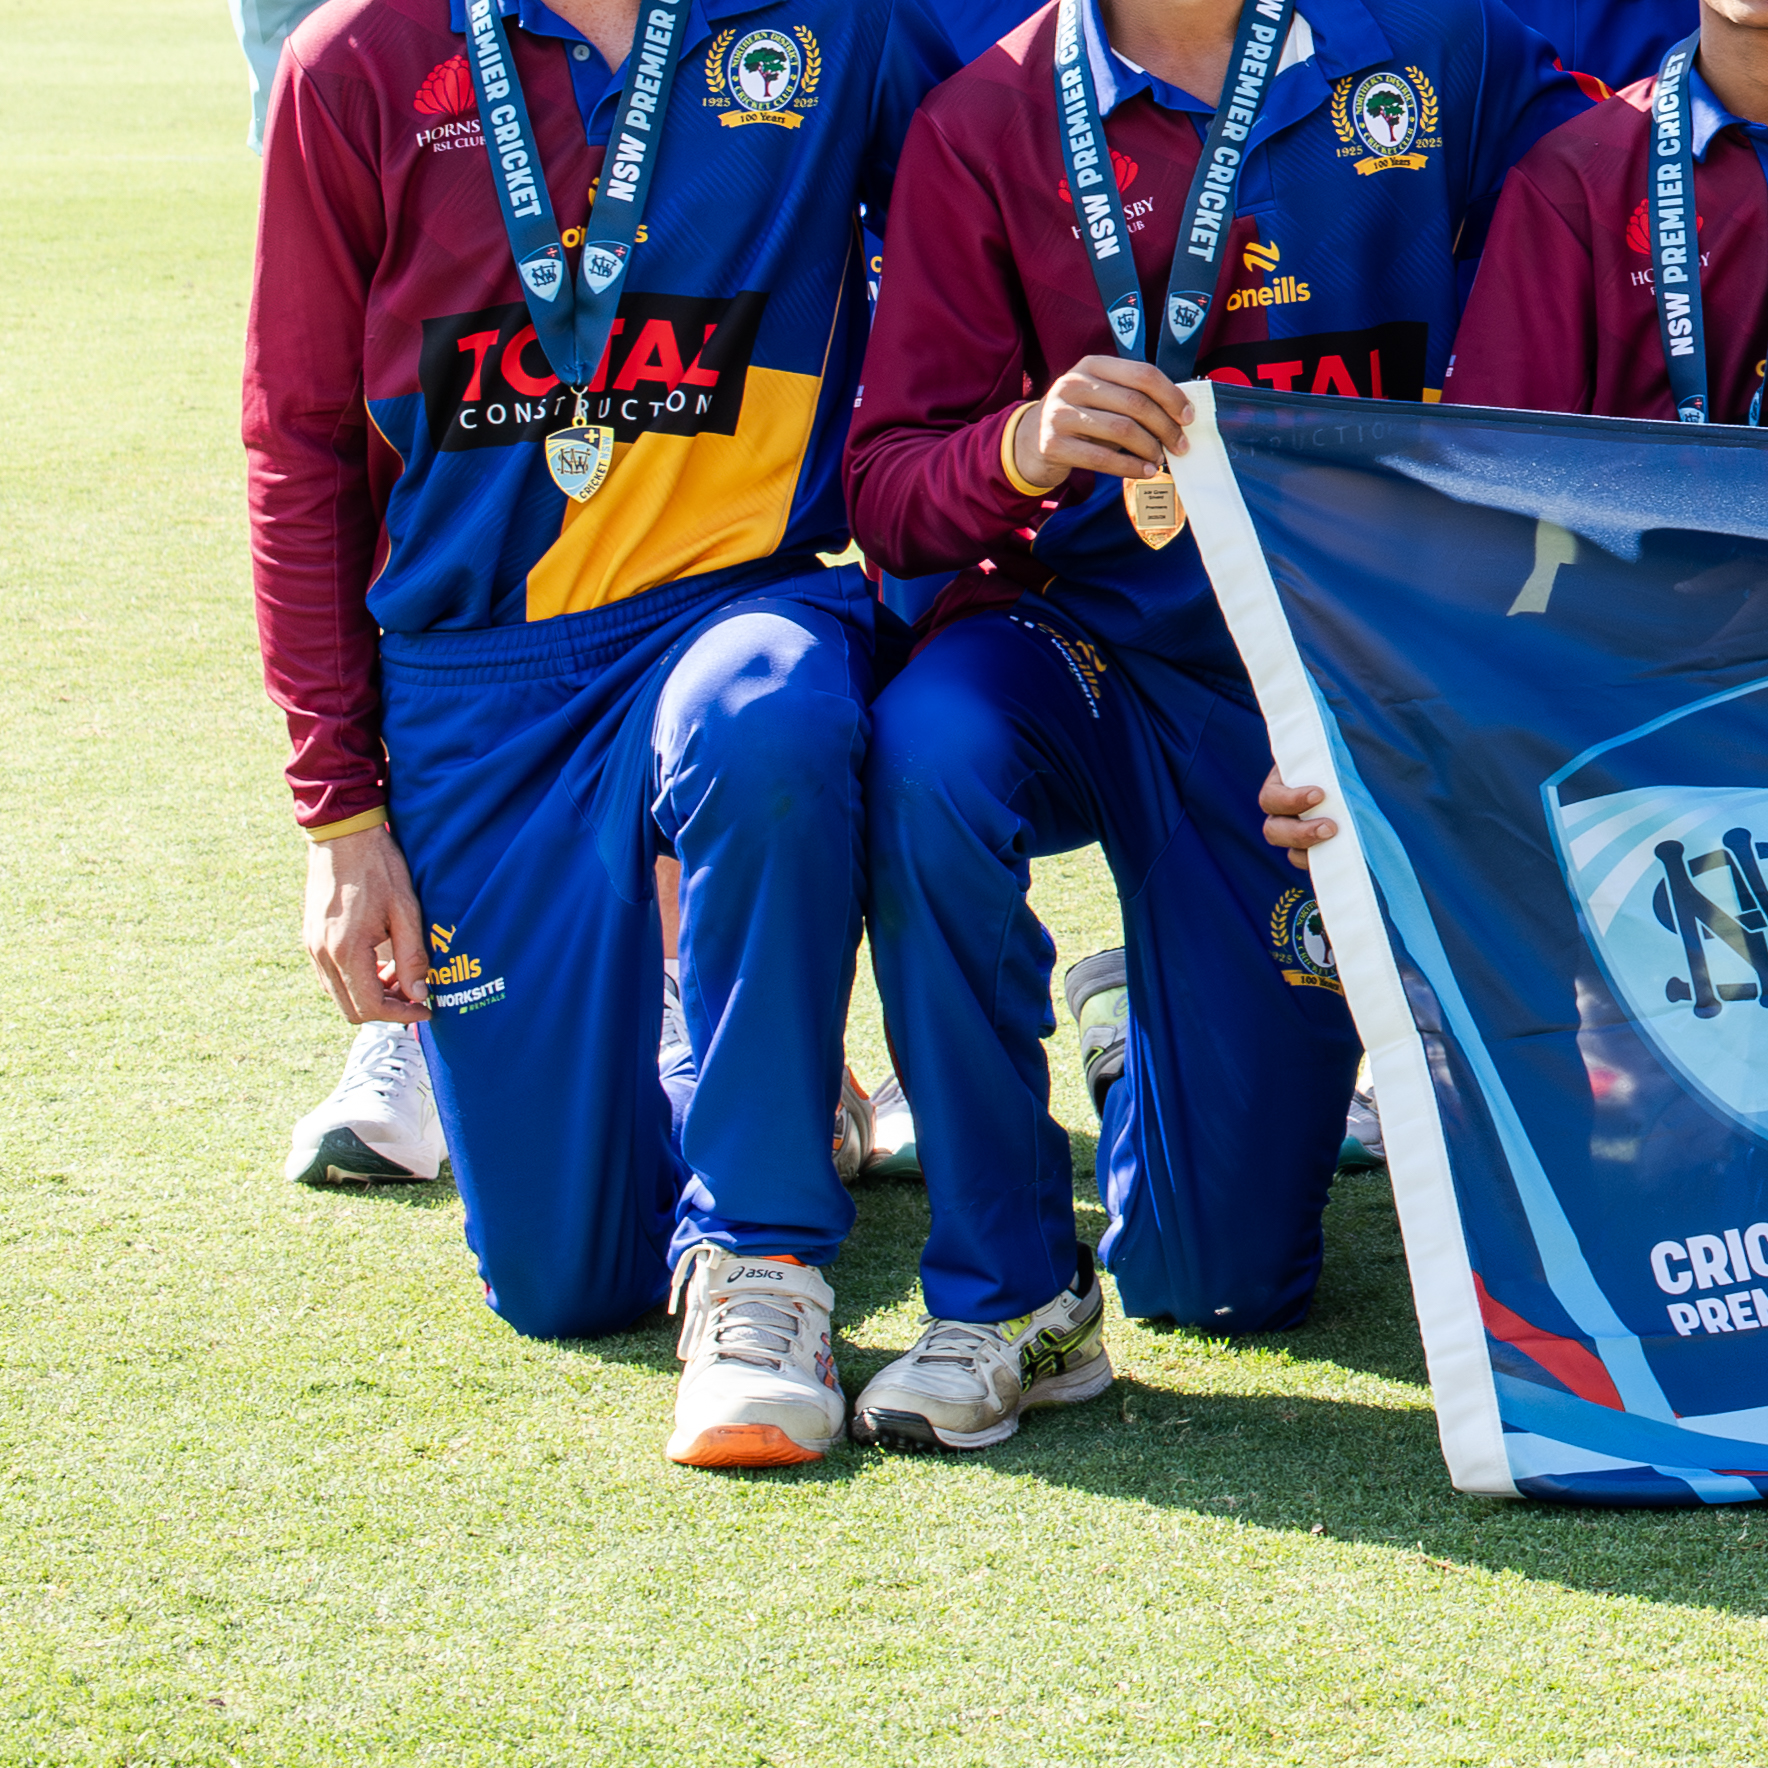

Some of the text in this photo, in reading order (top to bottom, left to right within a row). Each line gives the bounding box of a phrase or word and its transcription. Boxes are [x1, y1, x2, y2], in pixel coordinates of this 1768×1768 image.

[733, 83, 795, 111] CRICKET CLUB
[1220, 23, 1278, 143] PREMIER
[606, 132, 648, 203] NSW
[627, 14, 677, 132] PREMIER
[703, 96, 819, 108] 1925 2025
[740, 111, 787, 125] 100 Years
[434, 140, 453, 153] RSL
[490, 100, 541, 218] CRICKET
[1335, 136, 1443, 158] 1925 2025
[1062, 70, 1121, 260] NSW PREMIER
[1373, 155, 1412, 171] 100 Years
[1188, 146, 1241, 263] CRICKET
[1655, 51, 1695, 357] NSW PREMIER CRICKET
[579, 462, 608, 499] CRICKET
[425, 953, 482, 985] neills
[436, 977, 505, 1007] WORKSITE
[469, 992, 506, 1011] RENTALS
[745, 1268, 784, 1281] asics
